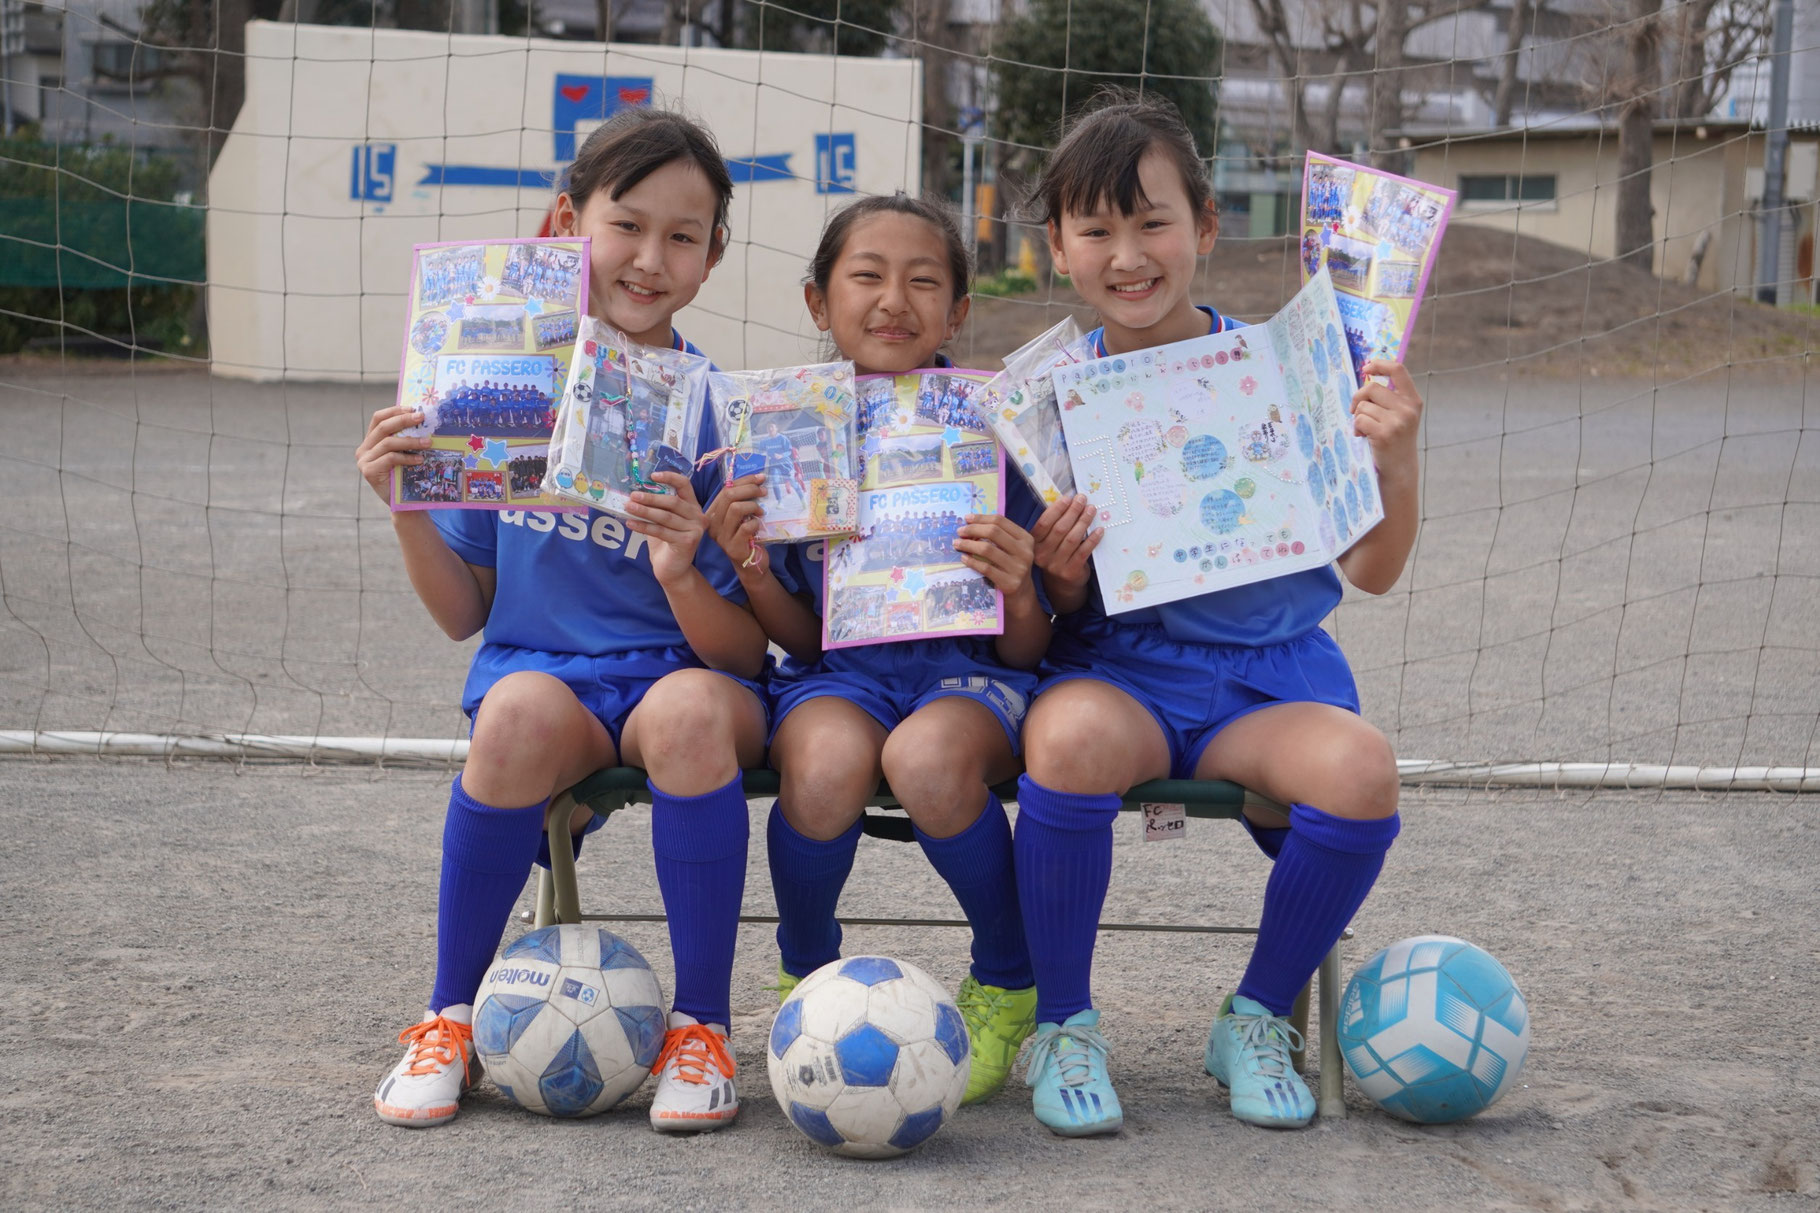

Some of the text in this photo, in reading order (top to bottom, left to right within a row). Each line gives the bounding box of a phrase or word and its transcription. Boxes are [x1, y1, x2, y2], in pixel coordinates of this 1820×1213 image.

[446, 359, 543, 376] FC PASSERO
[869, 487, 961, 510] FC PASSERO
[1142, 803, 1162, 817] FC
[489, 966, 551, 987] molten
